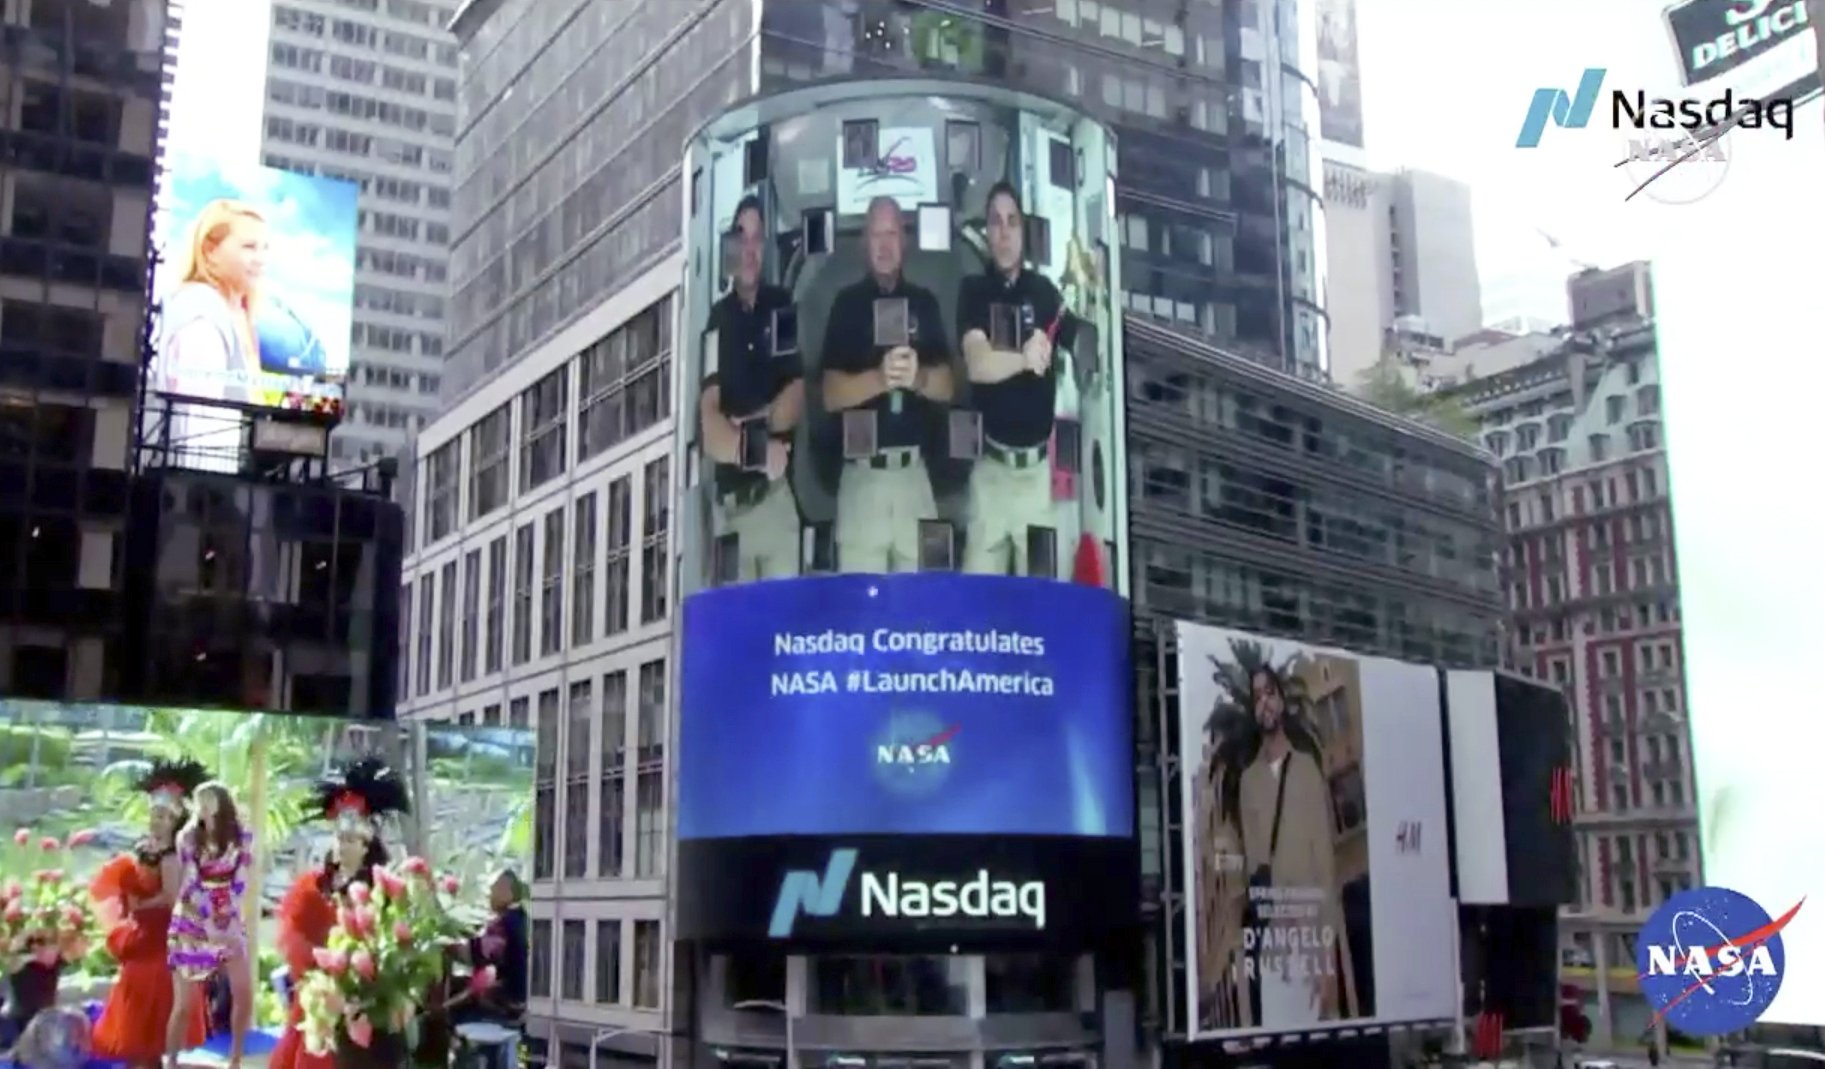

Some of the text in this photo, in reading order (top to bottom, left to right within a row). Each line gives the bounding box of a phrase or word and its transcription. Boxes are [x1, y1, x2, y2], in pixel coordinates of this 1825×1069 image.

[775, 628, 1045, 656] Nasdaq Congratulates
[771, 668, 1054, 696] NASA #LaunchAmerica
[878, 744, 950, 764] NASA
[860, 869, 1046, 930] Nasdaq
[1243, 926, 1334, 950] D'ANGELO
